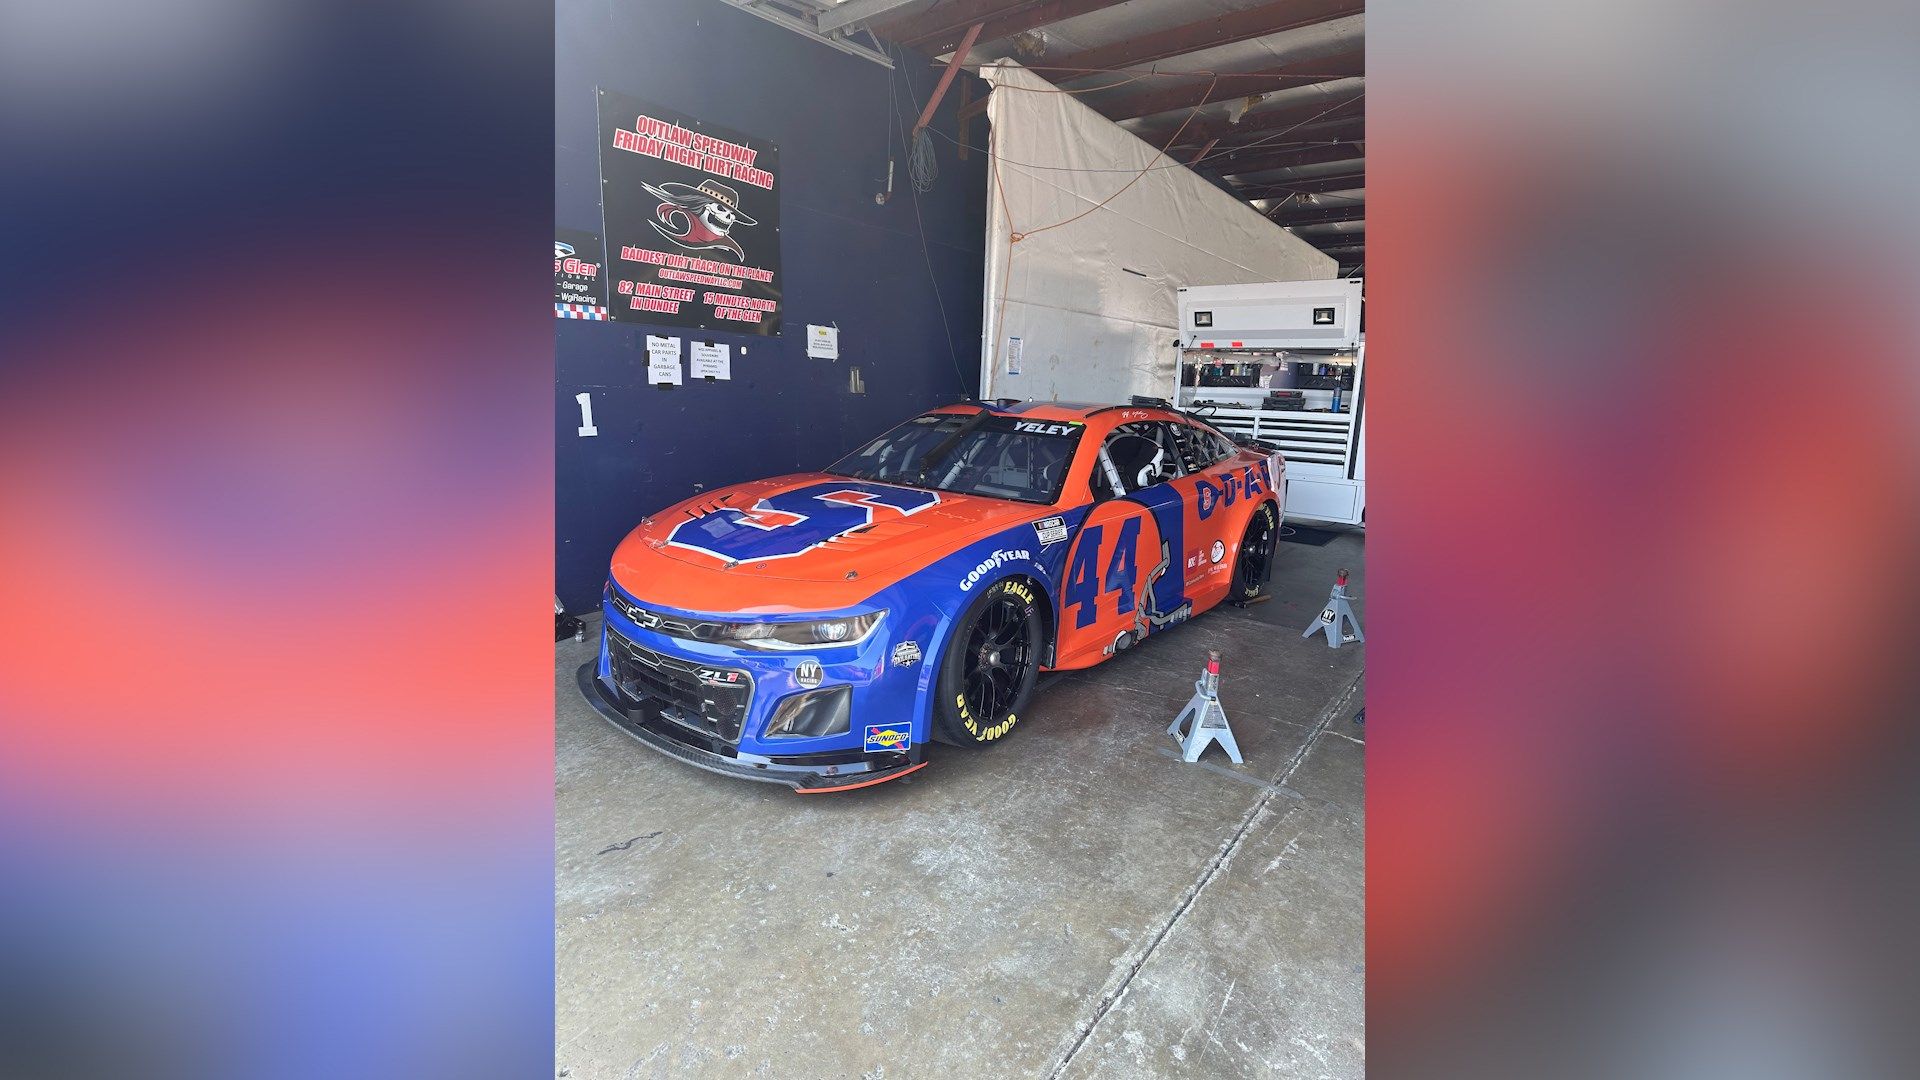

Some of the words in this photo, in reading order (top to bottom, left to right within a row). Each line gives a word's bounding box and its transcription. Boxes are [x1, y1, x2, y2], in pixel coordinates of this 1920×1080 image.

[636, 115, 694, 148] OUTLAW
[693, 133, 757, 166] SPEEDWAY
[613, 128, 665, 159] FRIDAY
[664, 144, 704, 170] NIGHT
[703, 154, 733, 178] DIRT
[733, 164, 773, 190] RACING
[621, 246, 668, 266] BADDEST
[667, 255, 691, 269] DIRT
[690, 257, 719, 273] TRACK
[719, 263, 732, 276] ON
[732, 265, 748, 278] THE
[748, 267, 774, 282] PLANET
[562, 281, 588, 292] Garage
[659, 268, 743, 289] OUTLAWSPEEDWAYLLC.COM
[561, 293, 597, 304] WgiRacing
[618, 280, 634, 294] 82
[636, 282, 662, 298] MAIN
[662, 286, 695, 302] STREET
[630, 297, 643, 310] IN
[643, 297, 680, 314] DUNDEE
[703, 292, 715, 304] 15
[714, 293, 751, 309] MINUTES
[751, 297, 776, 312] NORTH
[715, 306, 727, 318] OF
[727, 308, 743, 320] THE
[742, 310, 762, 323] GLEN
[575, 392, 598, 437] 1
[1013, 421, 1076, 436] YELEY
[960, 549, 1030, 592] GOODYEAR
[1064, 515, 1142, 630] 44
[1003, 581, 1034, 605] EAGLE
[1323, 609, 1335, 619] NY
[699, 669, 739, 682] ZL1
[801, 664, 818, 678] NY
[956, 692, 1016, 741] GOODYEAR
[868, 733, 909, 743] SUNOCO
